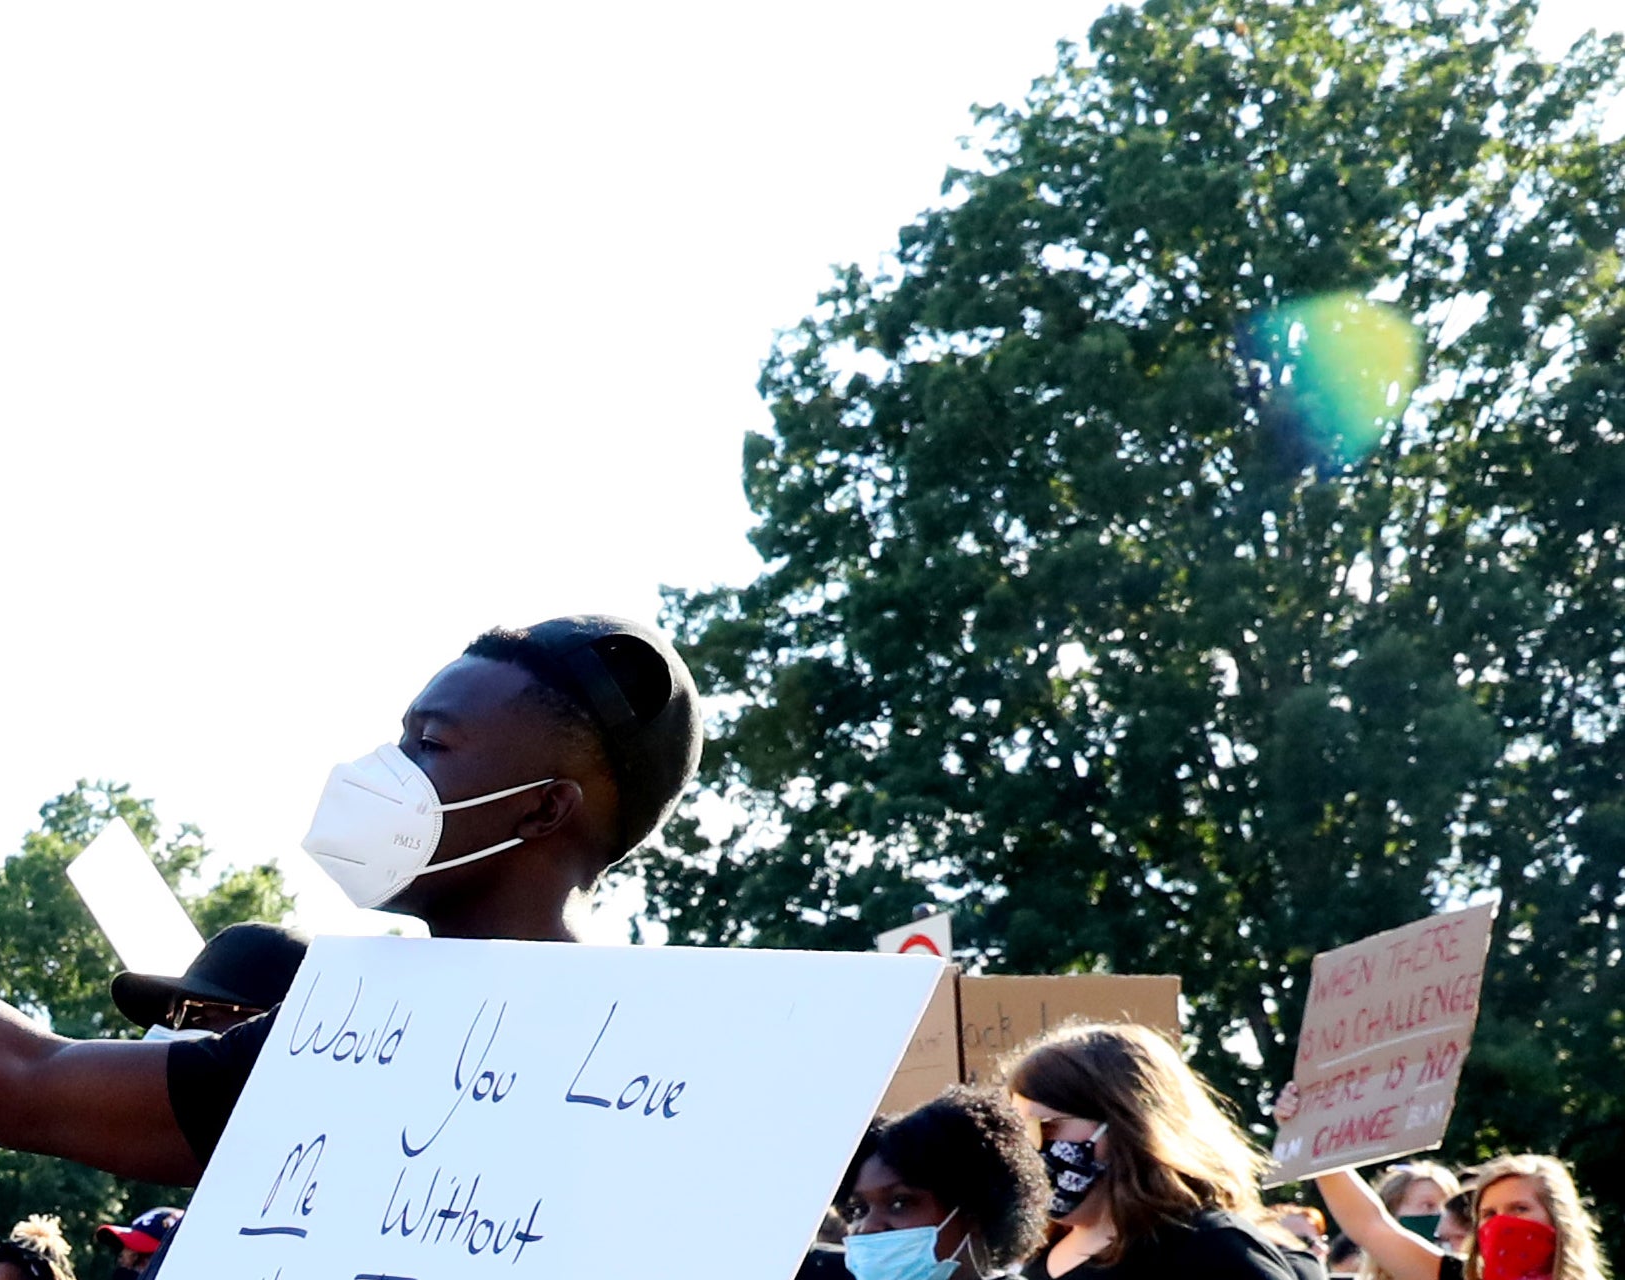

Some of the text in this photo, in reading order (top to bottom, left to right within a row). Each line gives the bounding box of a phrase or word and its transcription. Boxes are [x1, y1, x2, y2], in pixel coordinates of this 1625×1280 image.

[1389, 919, 1465, 980] THERE
[1353, 972, 1482, 1043] CHALLENGE
[288, 971, 687, 1158] Would You Love
[1383, 1055, 1408, 1091] IS
[1416, 1040, 1460, 1086] NO
[260, 1133, 545, 1265] Me Without
